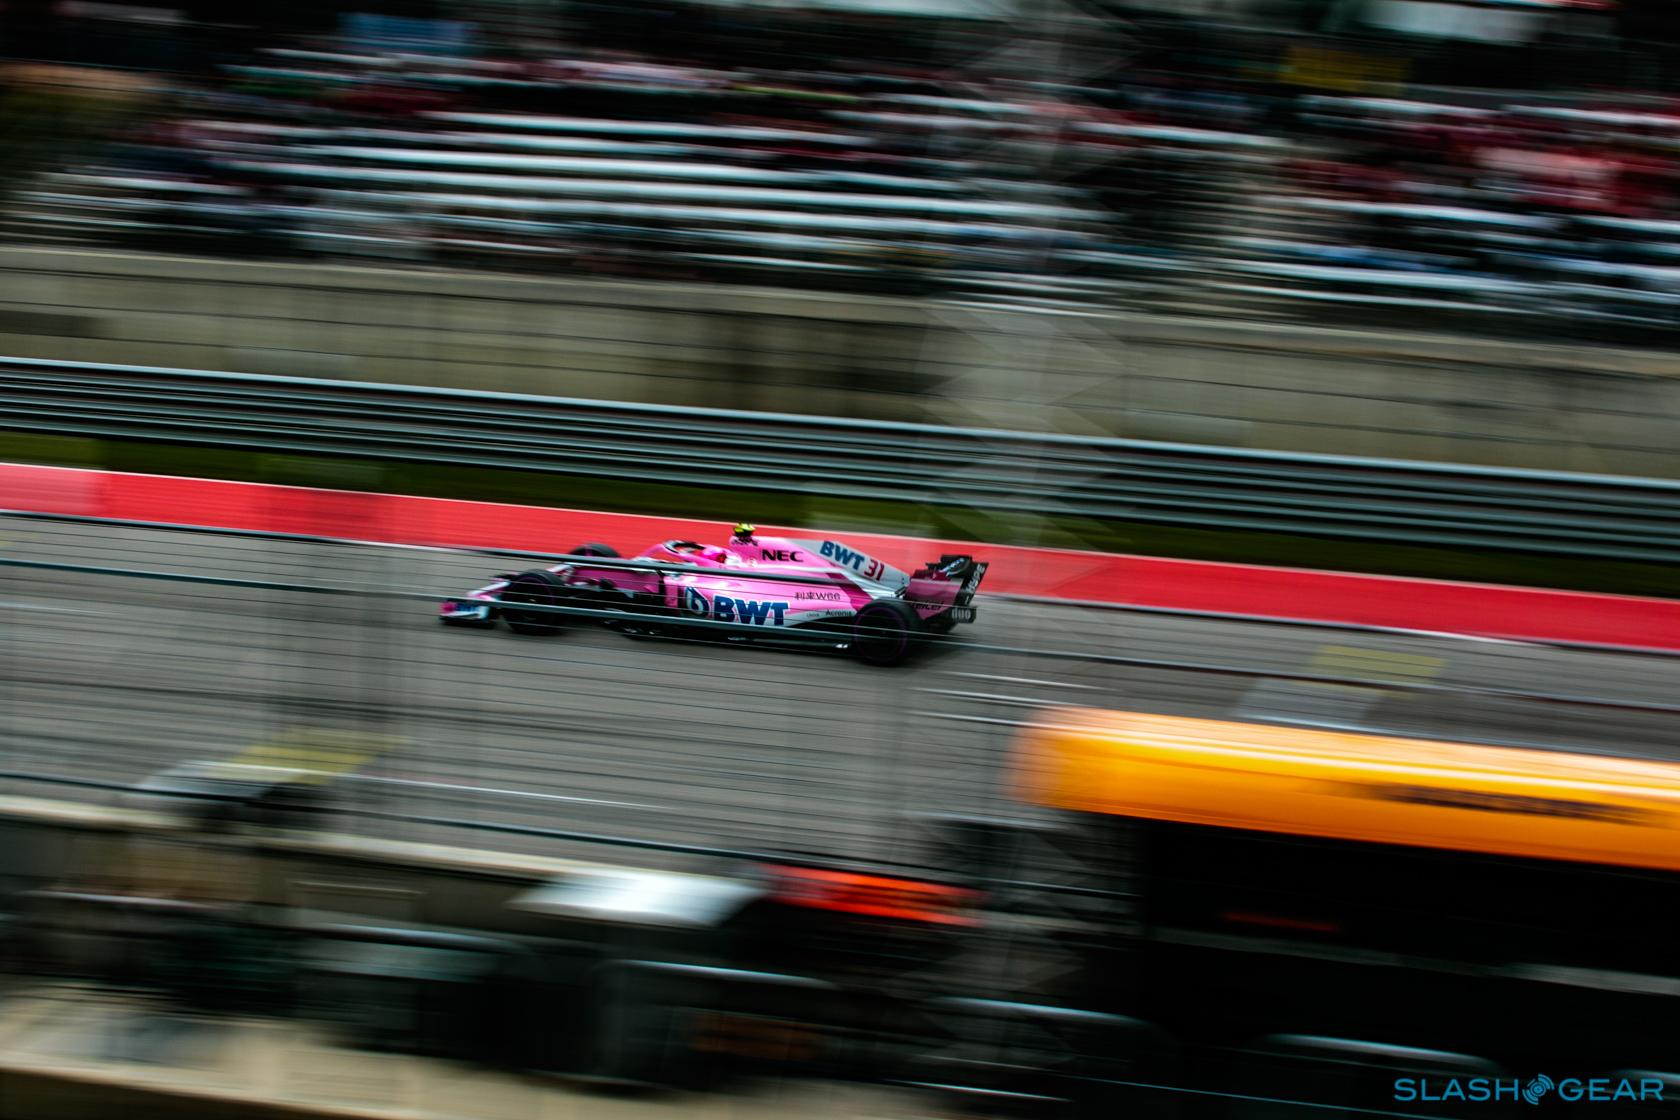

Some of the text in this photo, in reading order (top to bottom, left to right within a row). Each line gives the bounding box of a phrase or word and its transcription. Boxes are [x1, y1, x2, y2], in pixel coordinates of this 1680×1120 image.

[761, 549, 804, 563] NEC
[820, 541, 885, 581] BWT 31
[714, 595, 789, 626] BWT
